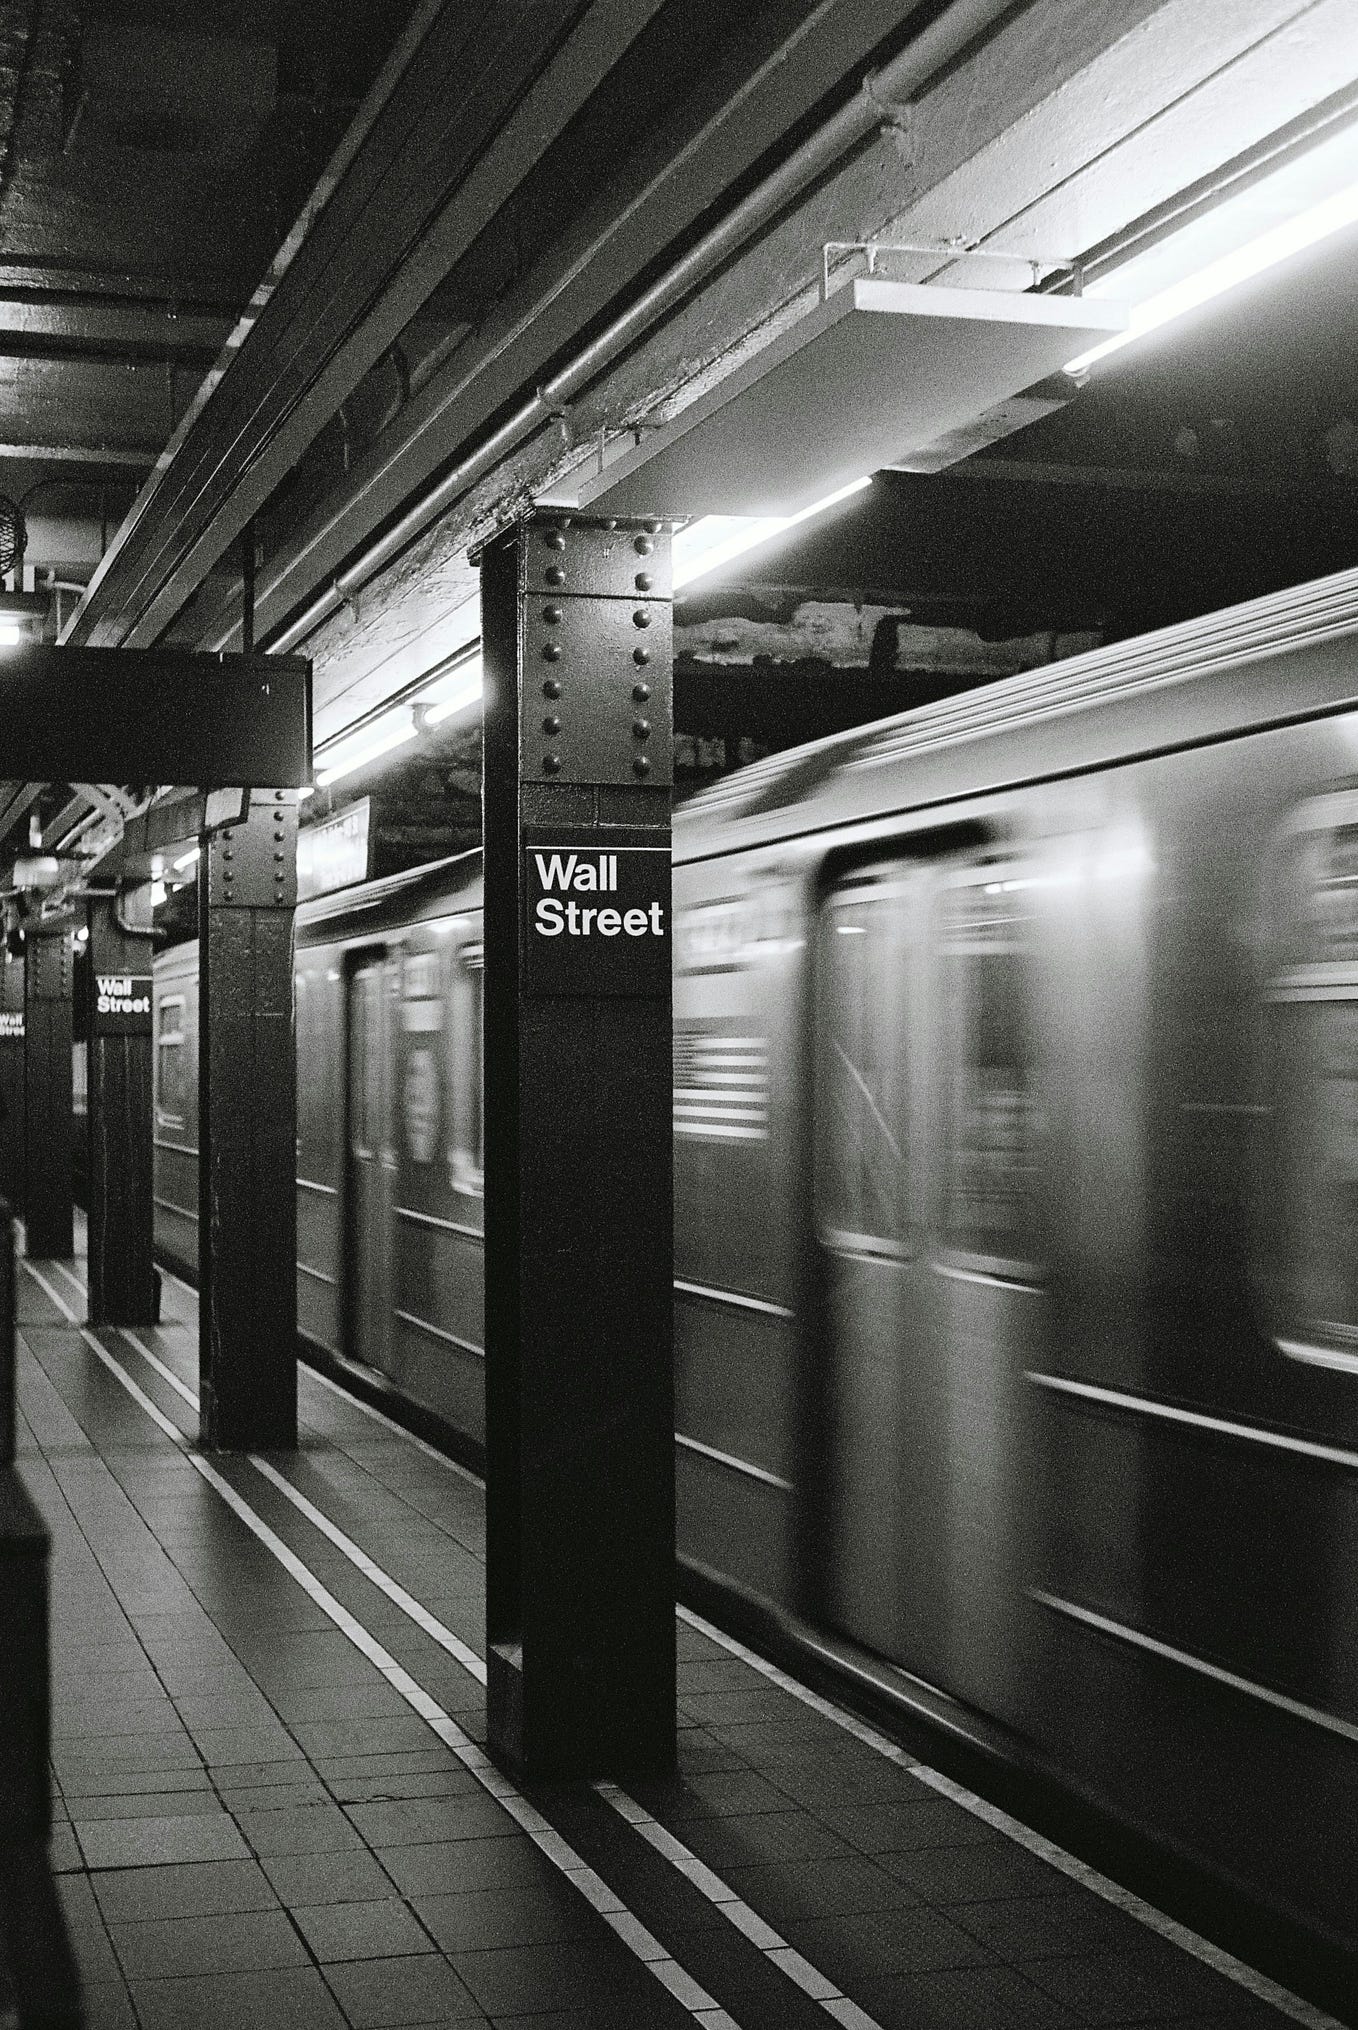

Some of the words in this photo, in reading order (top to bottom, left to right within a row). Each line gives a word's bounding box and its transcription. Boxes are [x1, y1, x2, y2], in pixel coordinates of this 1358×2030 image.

[535, 854, 617, 891] Wall
[535, 898, 664, 936] Street
[97, 979, 132, 996] Wall
[97, 995, 150, 1013] Street
